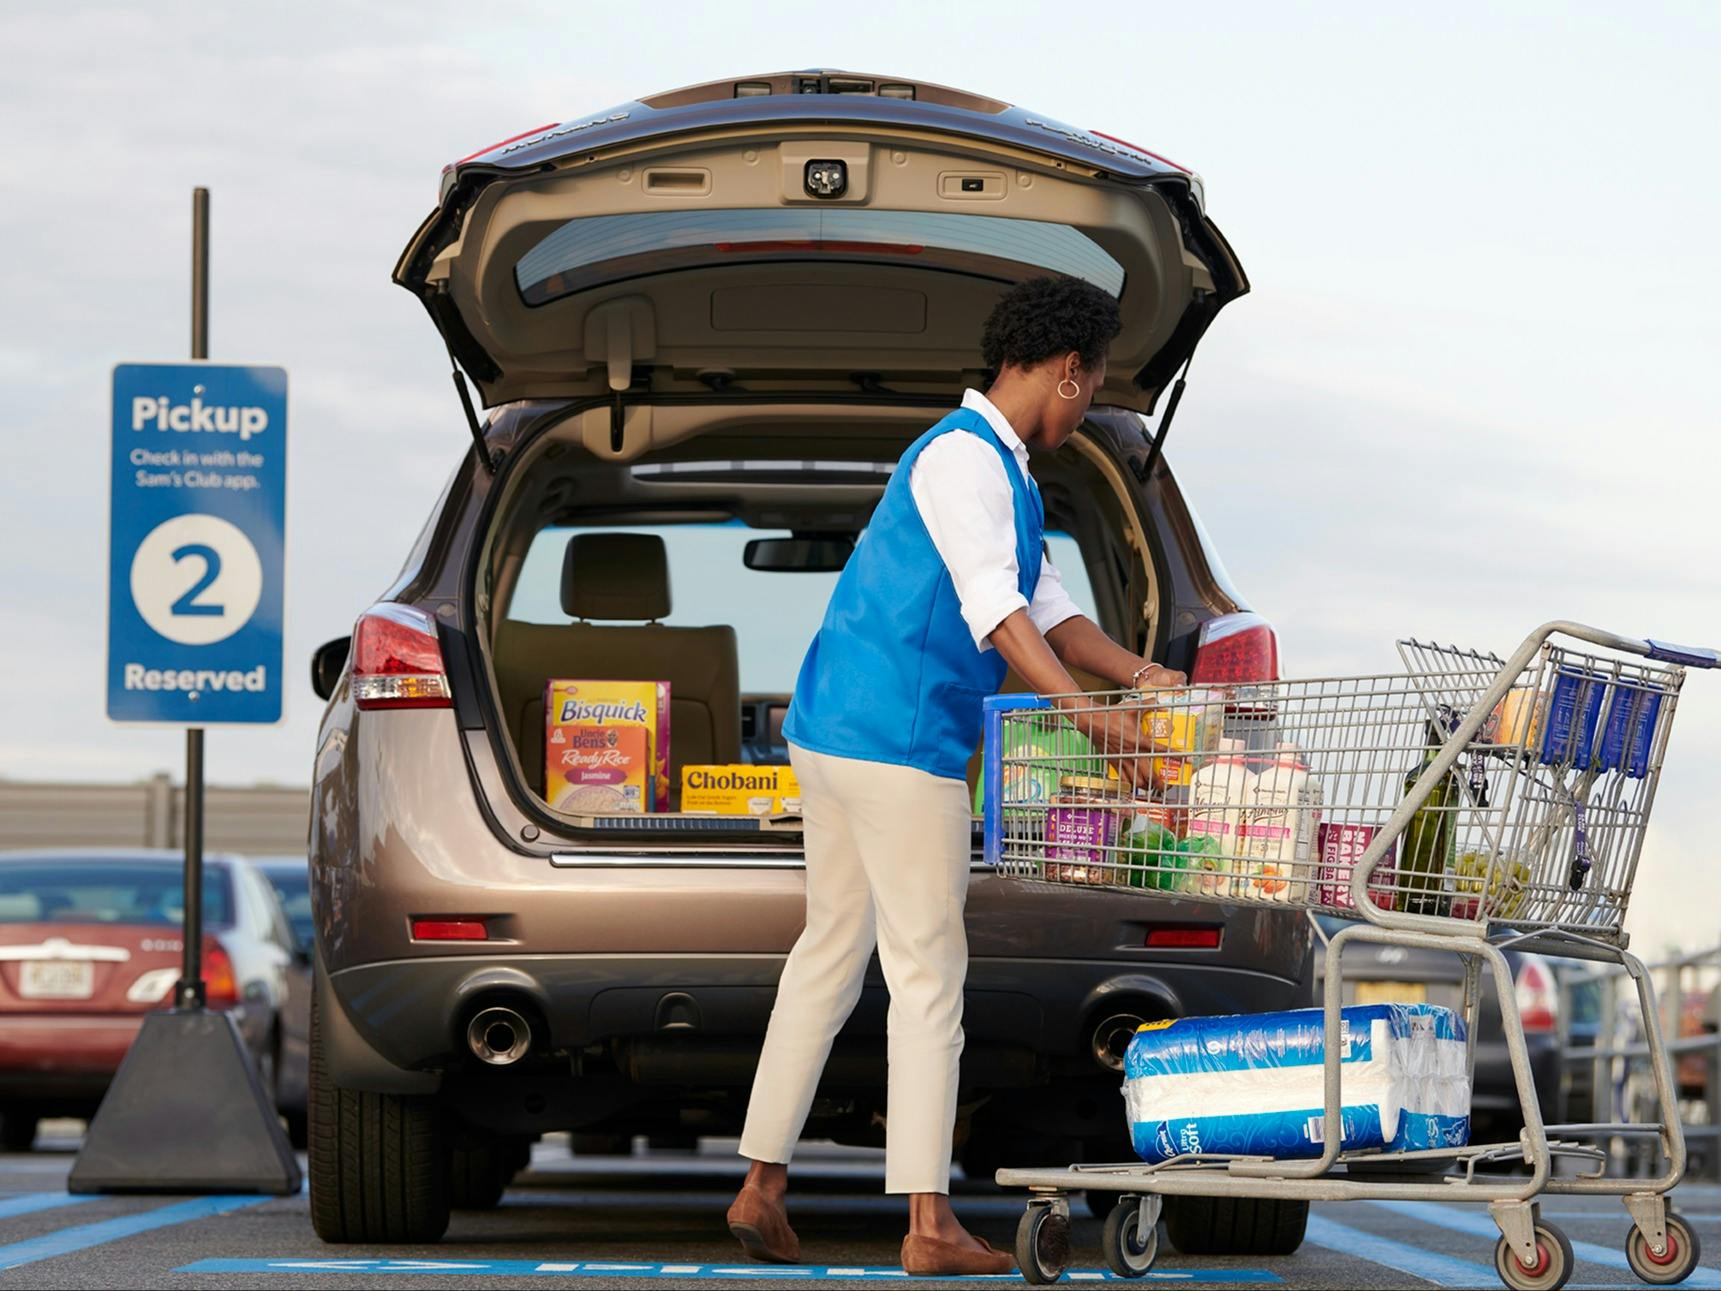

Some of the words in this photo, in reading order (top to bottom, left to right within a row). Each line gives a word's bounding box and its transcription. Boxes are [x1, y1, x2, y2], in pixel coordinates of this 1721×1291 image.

[132, 396, 268, 440] Pickup
[130, 448, 180, 466] Check
[182, 449, 199, 466] in
[201, 449, 235, 467] with
[236, 450, 264, 467] the
[135, 470, 183, 488] Sam's
[184, 470, 223, 488] Club
[170, 544, 225, 617] 2
[124, 663, 267, 692] Reserved
[561, 700, 648, 724] Bisquick
[580, 728, 605, 738] Uncle
[561, 749, 603, 769] Ready
[602, 749, 631, 767] Rice
[581, 771, 611, 782] Jasmine
[687, 771, 778, 790] Chobani
[1326, 846, 1336, 863] FIG
[1325, 867, 1335, 887] BA
[1186, 1122, 1203, 1154] Soft
